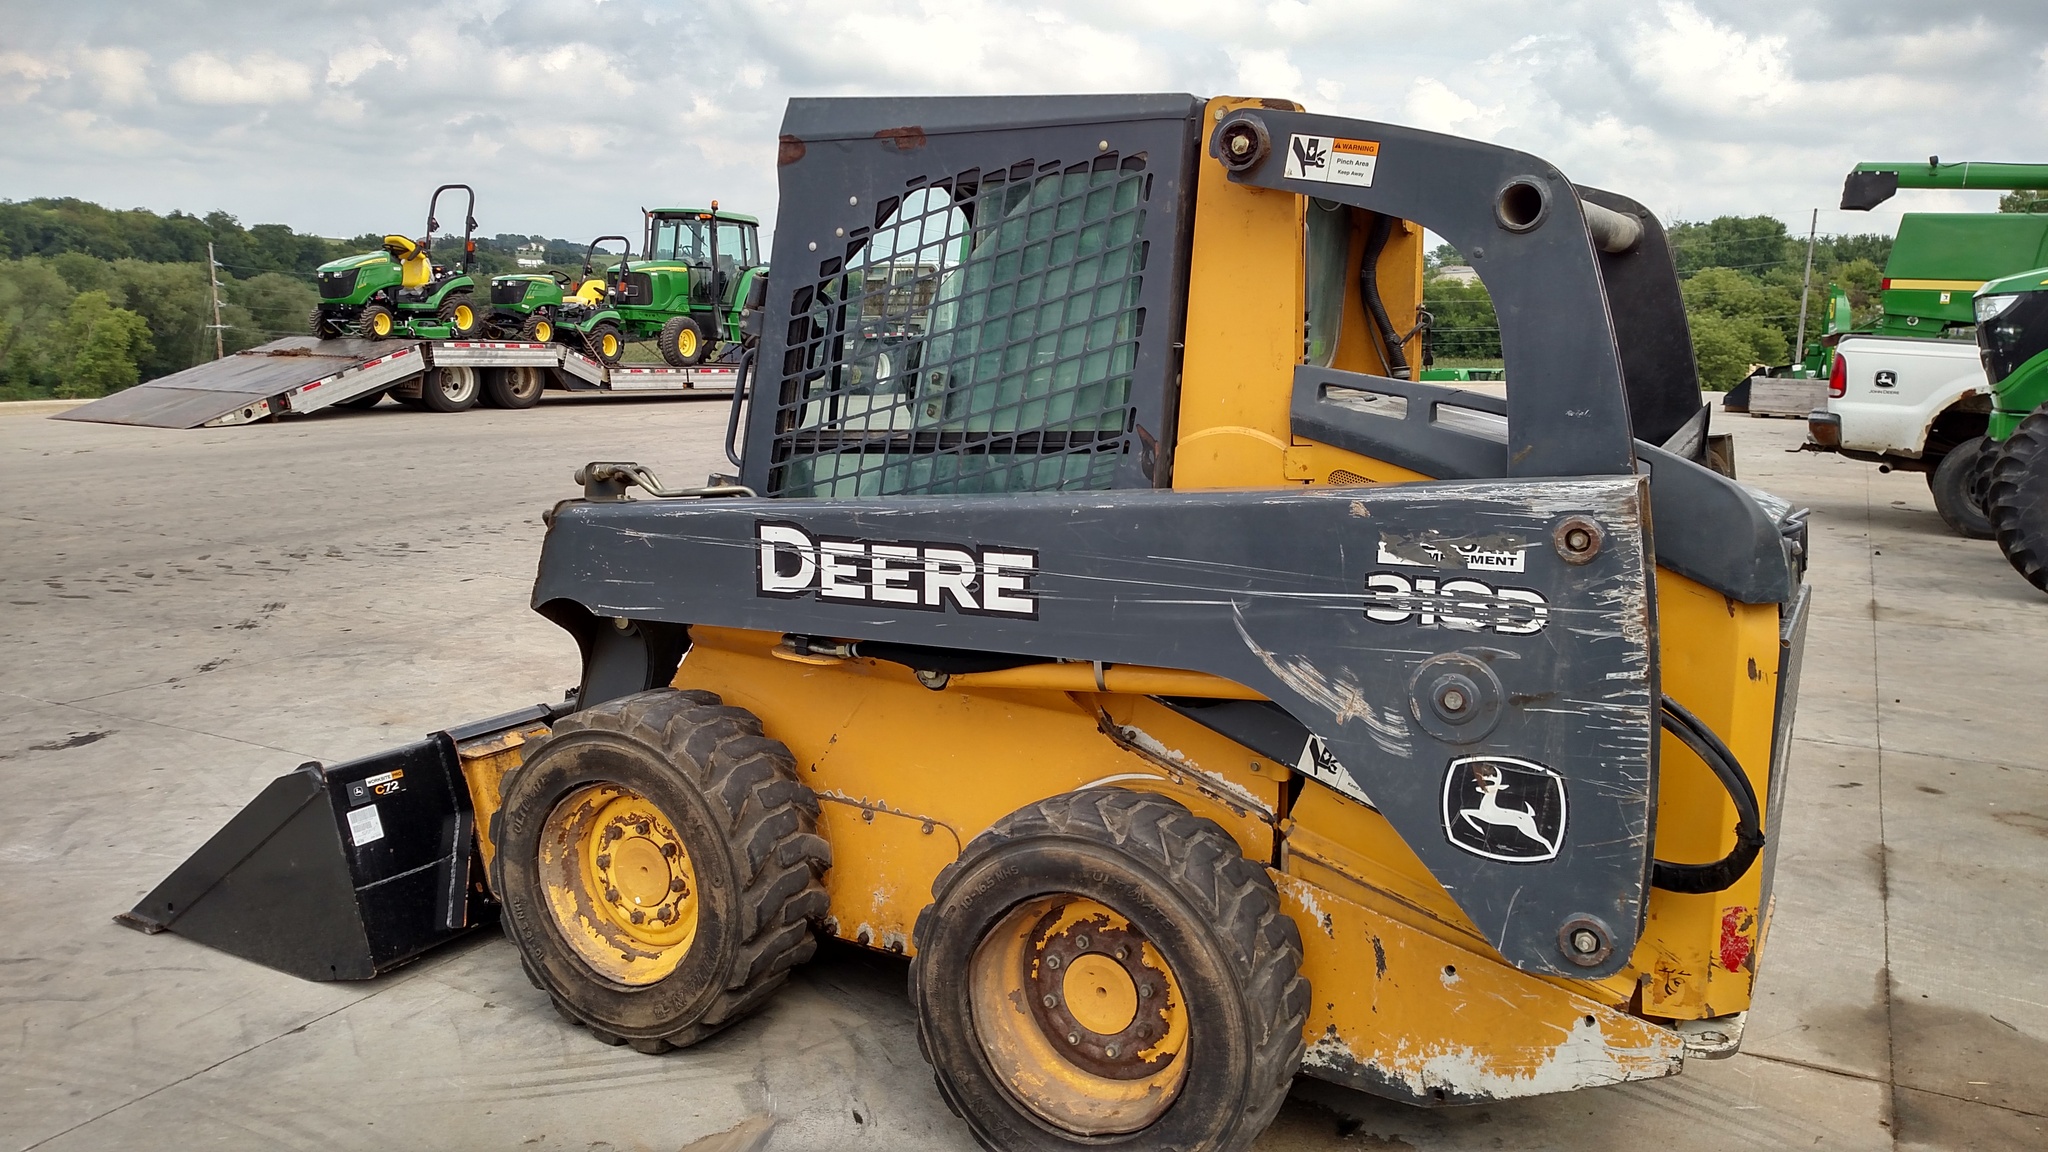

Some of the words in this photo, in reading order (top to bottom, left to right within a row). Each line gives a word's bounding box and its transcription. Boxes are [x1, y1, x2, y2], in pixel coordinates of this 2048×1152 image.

[1342, 143, 1374, 152] WARNING
[1336, 158, 1354, 166] Pinch
[1351, 170, 1364, 178] Away
[759, 524, 1034, 614] DEERE
[367, 775, 391, 785] WORKSITE
[375, 781, 400, 795] C72
[1347, 782, 1359, 791] Keep
[995, 865, 1019, 882] NHS
